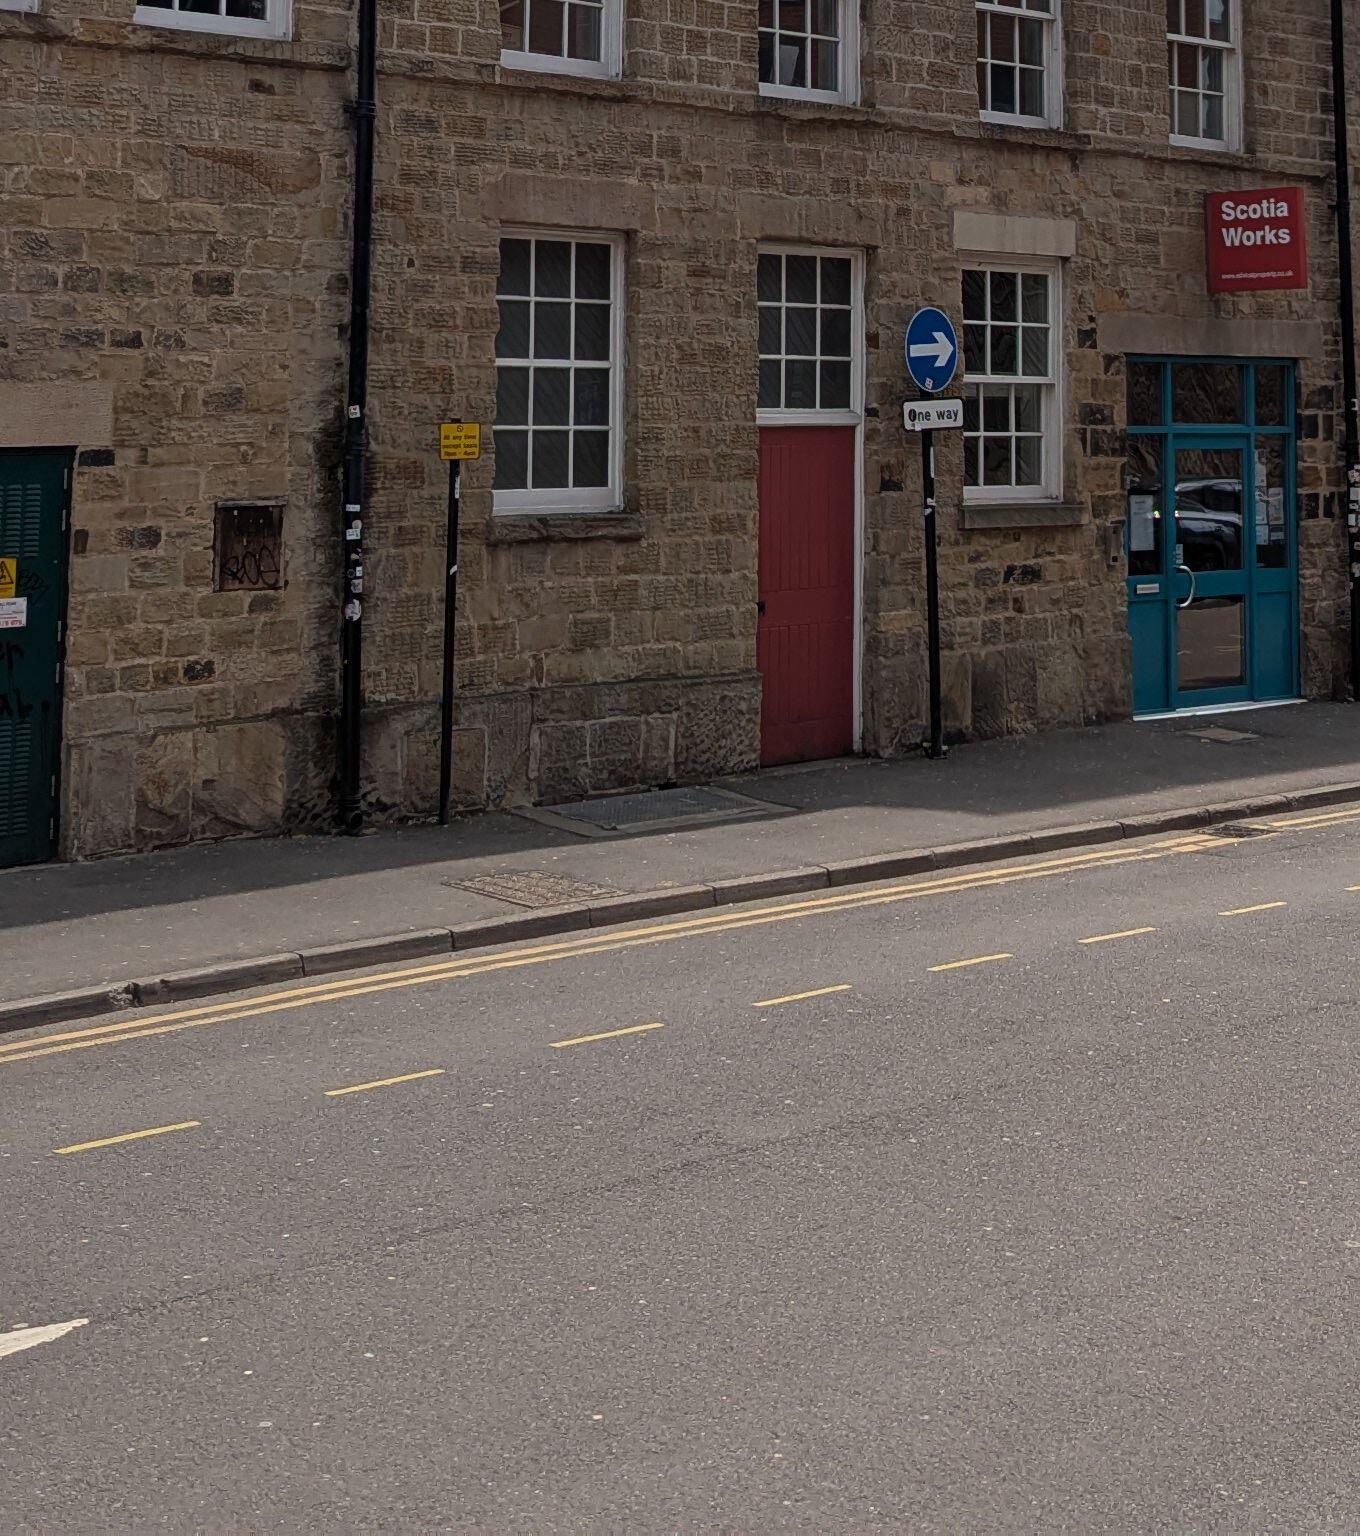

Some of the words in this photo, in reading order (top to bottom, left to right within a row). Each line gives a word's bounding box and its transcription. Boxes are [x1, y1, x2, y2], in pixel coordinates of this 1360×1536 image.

[1221, 197, 1289, 221] Scotia
[1221, 225, 1291, 247] Works
[908, 408, 931, 423] One
[935, 409, 959, 423] way
